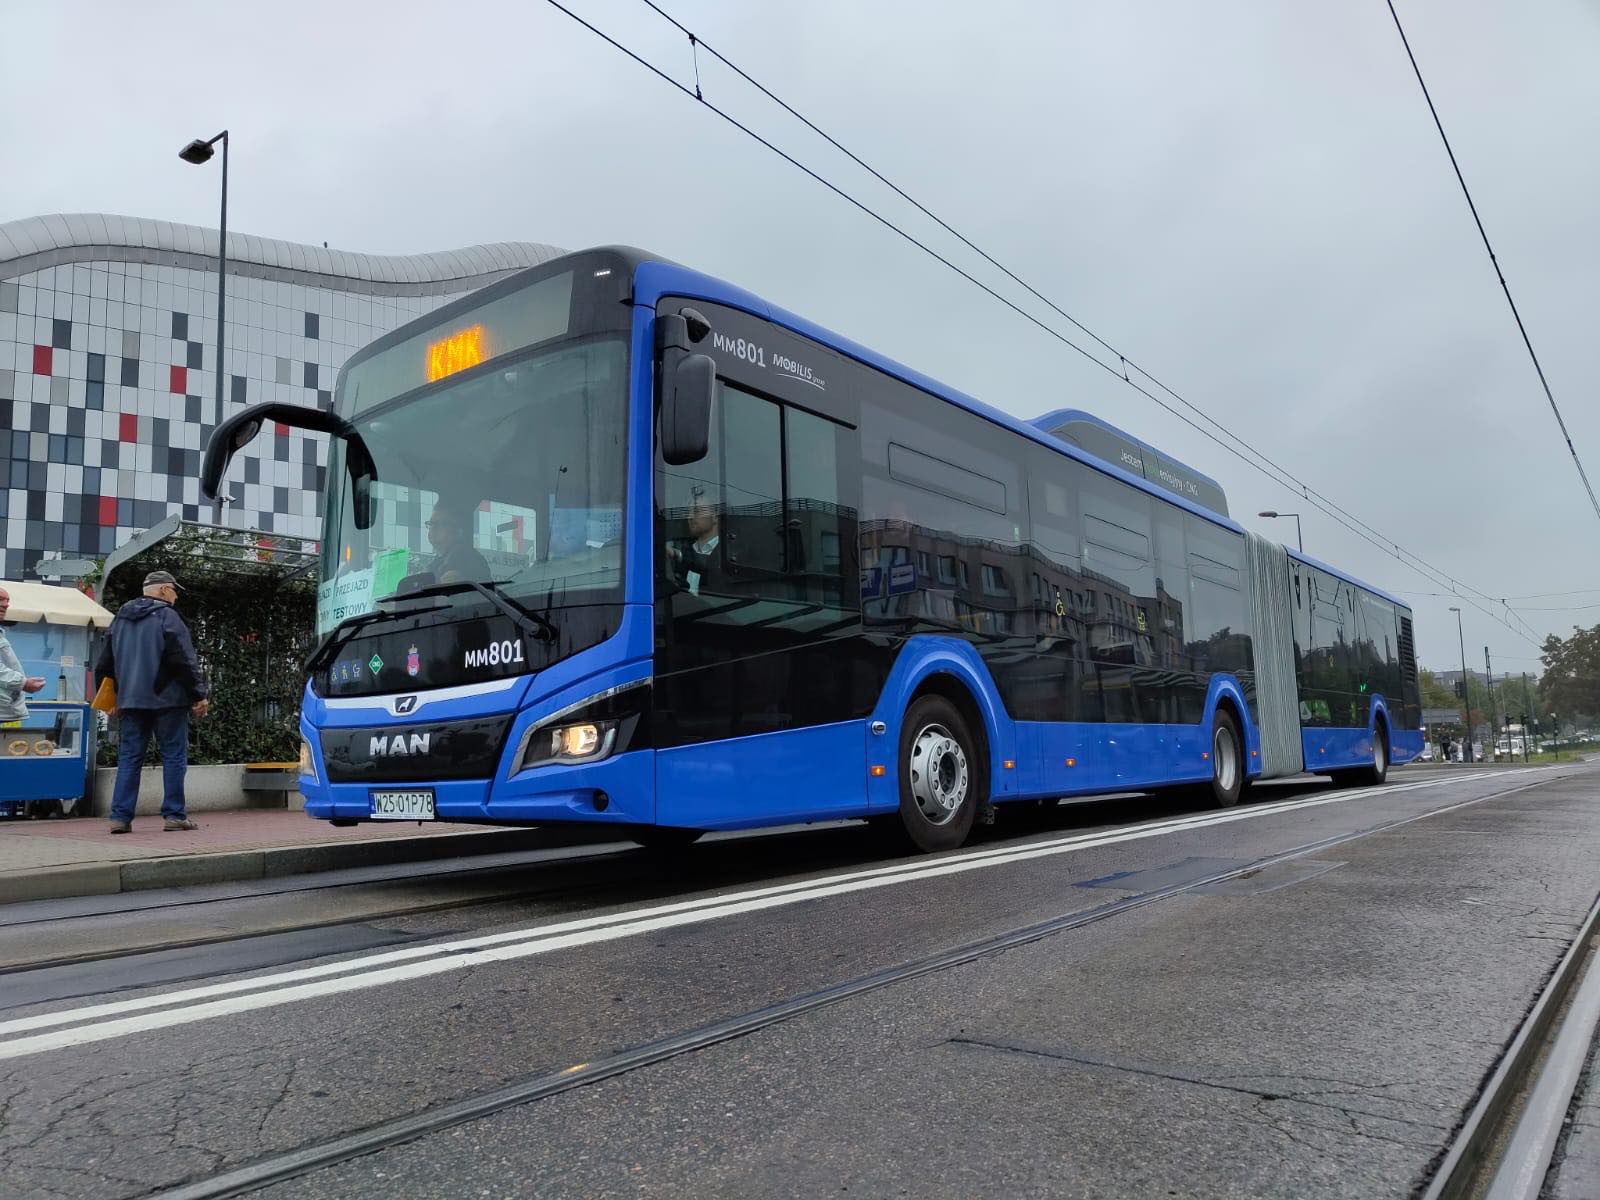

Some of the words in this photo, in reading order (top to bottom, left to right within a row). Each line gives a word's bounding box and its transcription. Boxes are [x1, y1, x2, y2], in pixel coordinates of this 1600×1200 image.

[713, 332, 766, 368] MM801
[773, 353, 812, 380] MOBILIS
[336, 579, 369, 597] PRZEJAZD
[334, 602, 368, 619] TESTOWY
[465, 640, 524, 668] MM801
[369, 733, 431, 756] MAN
